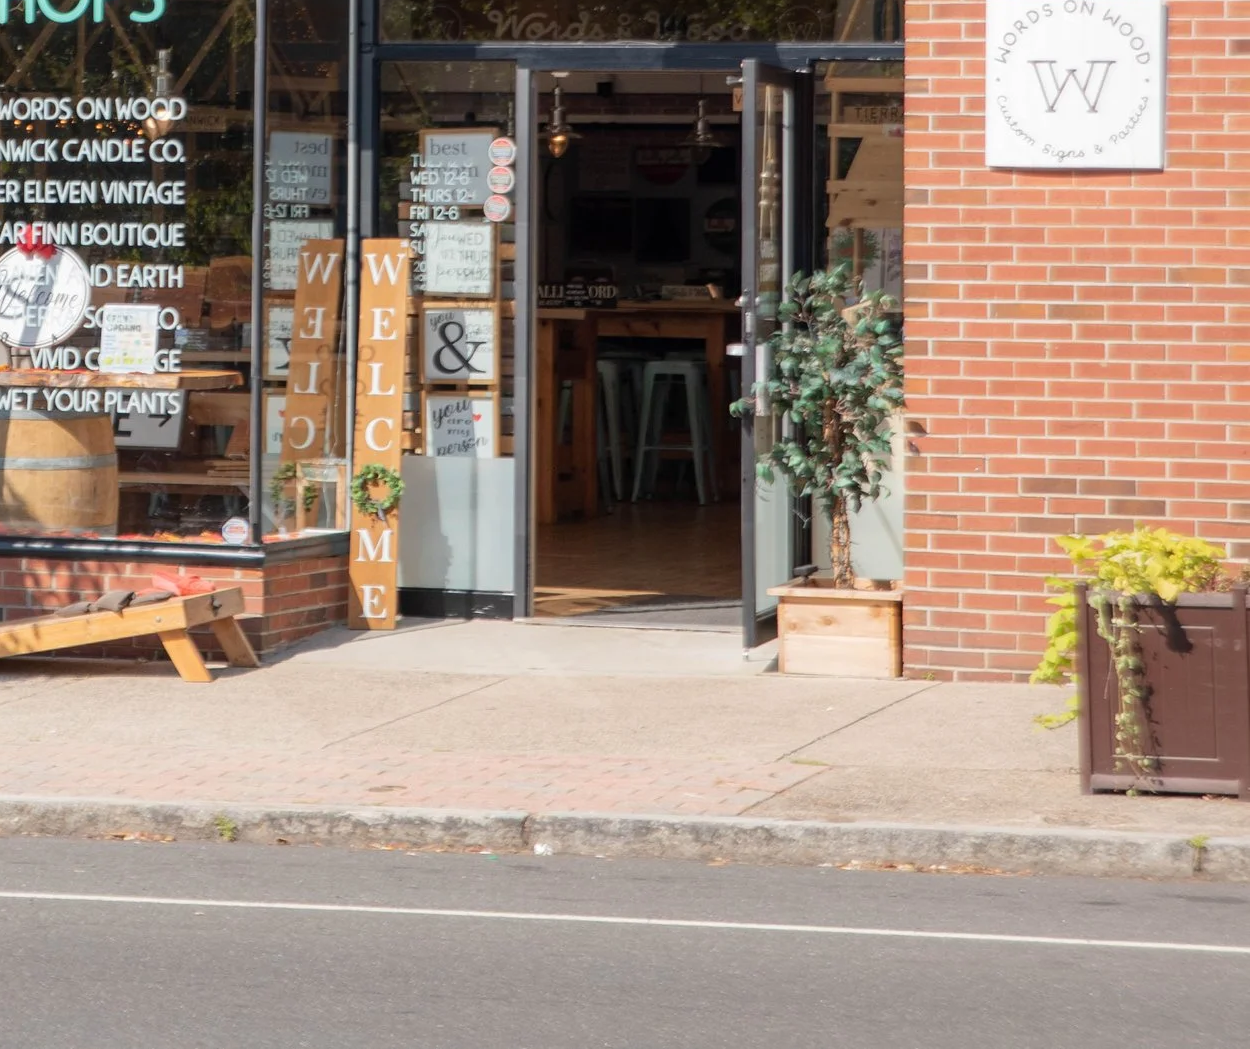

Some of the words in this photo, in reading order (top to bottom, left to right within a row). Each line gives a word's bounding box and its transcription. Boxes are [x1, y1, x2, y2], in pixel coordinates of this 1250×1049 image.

[994, 3, 1054, 64] WORDS
[1063, 0, 1095, 16] ON
[1102, 8, 1151, 64] WOOD
[1027, 59, 1117, 113] W
[76, 98, 112, 121] ON
[115, 98, 188, 121] WOOD
[853, 107, 902, 120] TIERR
[996, 95, 1036, 146] Custom
[1041, 143, 1085, 162] Signs
[1108, 95, 1149, 145] Parties
[62, 139, 146, 163] CANDLE
[149, 139, 187, 163] CO.
[430, 138, 468, 156] best
[410, 171, 439, 186] WED
[444, 171, 471, 186] 12-6
[24, 180, 98, 204] ELEVEN
[101, 180, 186, 205] VINTAGE
[410, 188, 450, 203] THURS
[409, 205, 430, 220] FRI
[433, 205, 460, 220] 12-6
[32, 221, 78, 246] FINN
[81, 221, 186, 248] BOUTIQUE
[409, 223, 426, 238] SA
[116, 264, 185, 288] EARTH
[41, 389, 100, 413] YOUR
[104, 389, 182, 415] PLANTS
[433, 400, 471, 429] you
[447, 418, 472, 426] are
